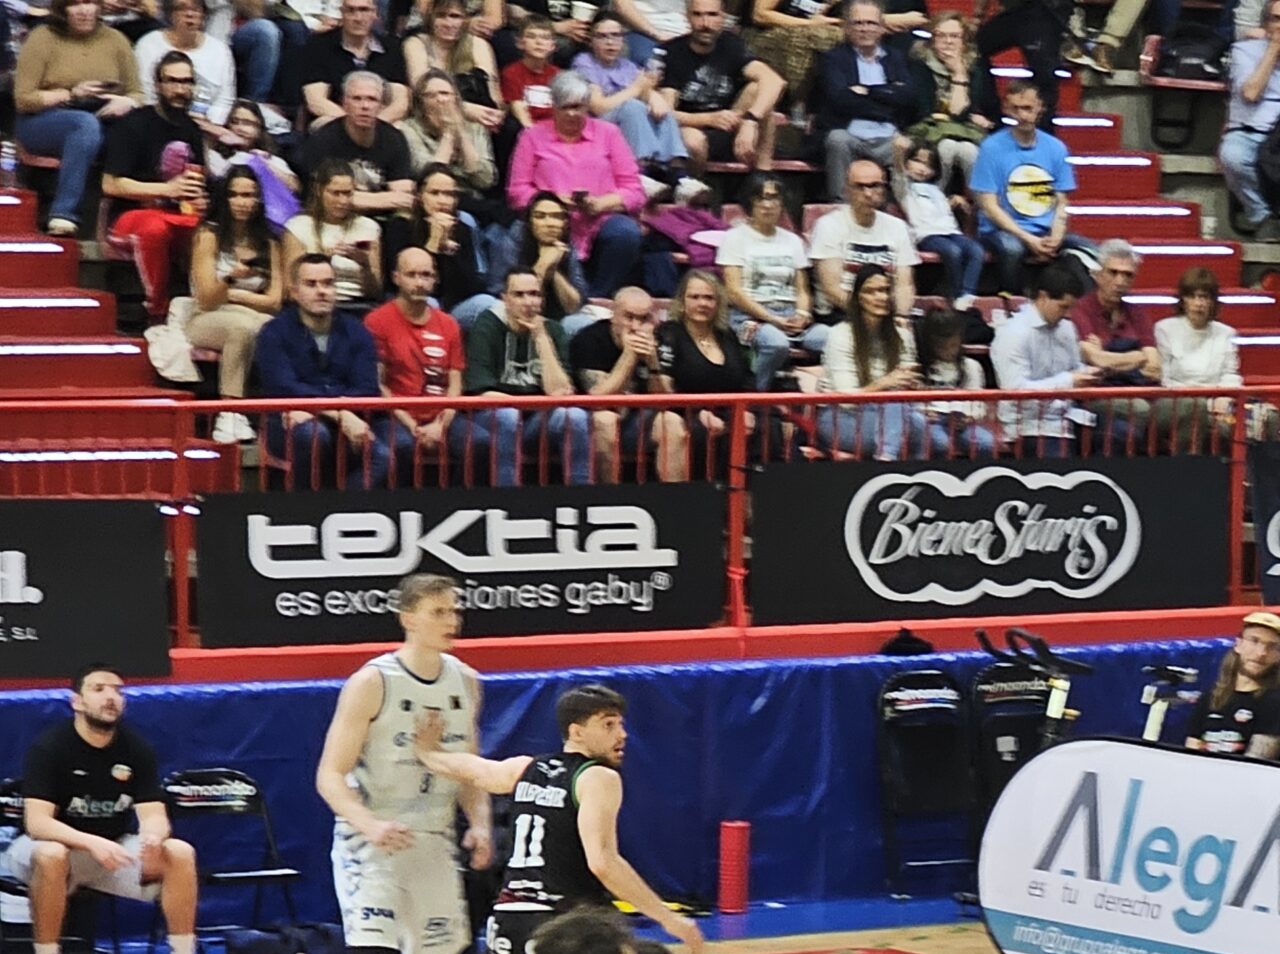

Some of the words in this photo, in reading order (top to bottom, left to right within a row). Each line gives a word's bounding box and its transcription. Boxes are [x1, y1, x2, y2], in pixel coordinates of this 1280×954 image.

[275, 591, 321, 616] es
[509, 813, 546, 868] 11
[1028, 881, 1046, 898] es
[1062, 883, 1079, 905] tu
[1094, 887, 1163, 920] derecho
